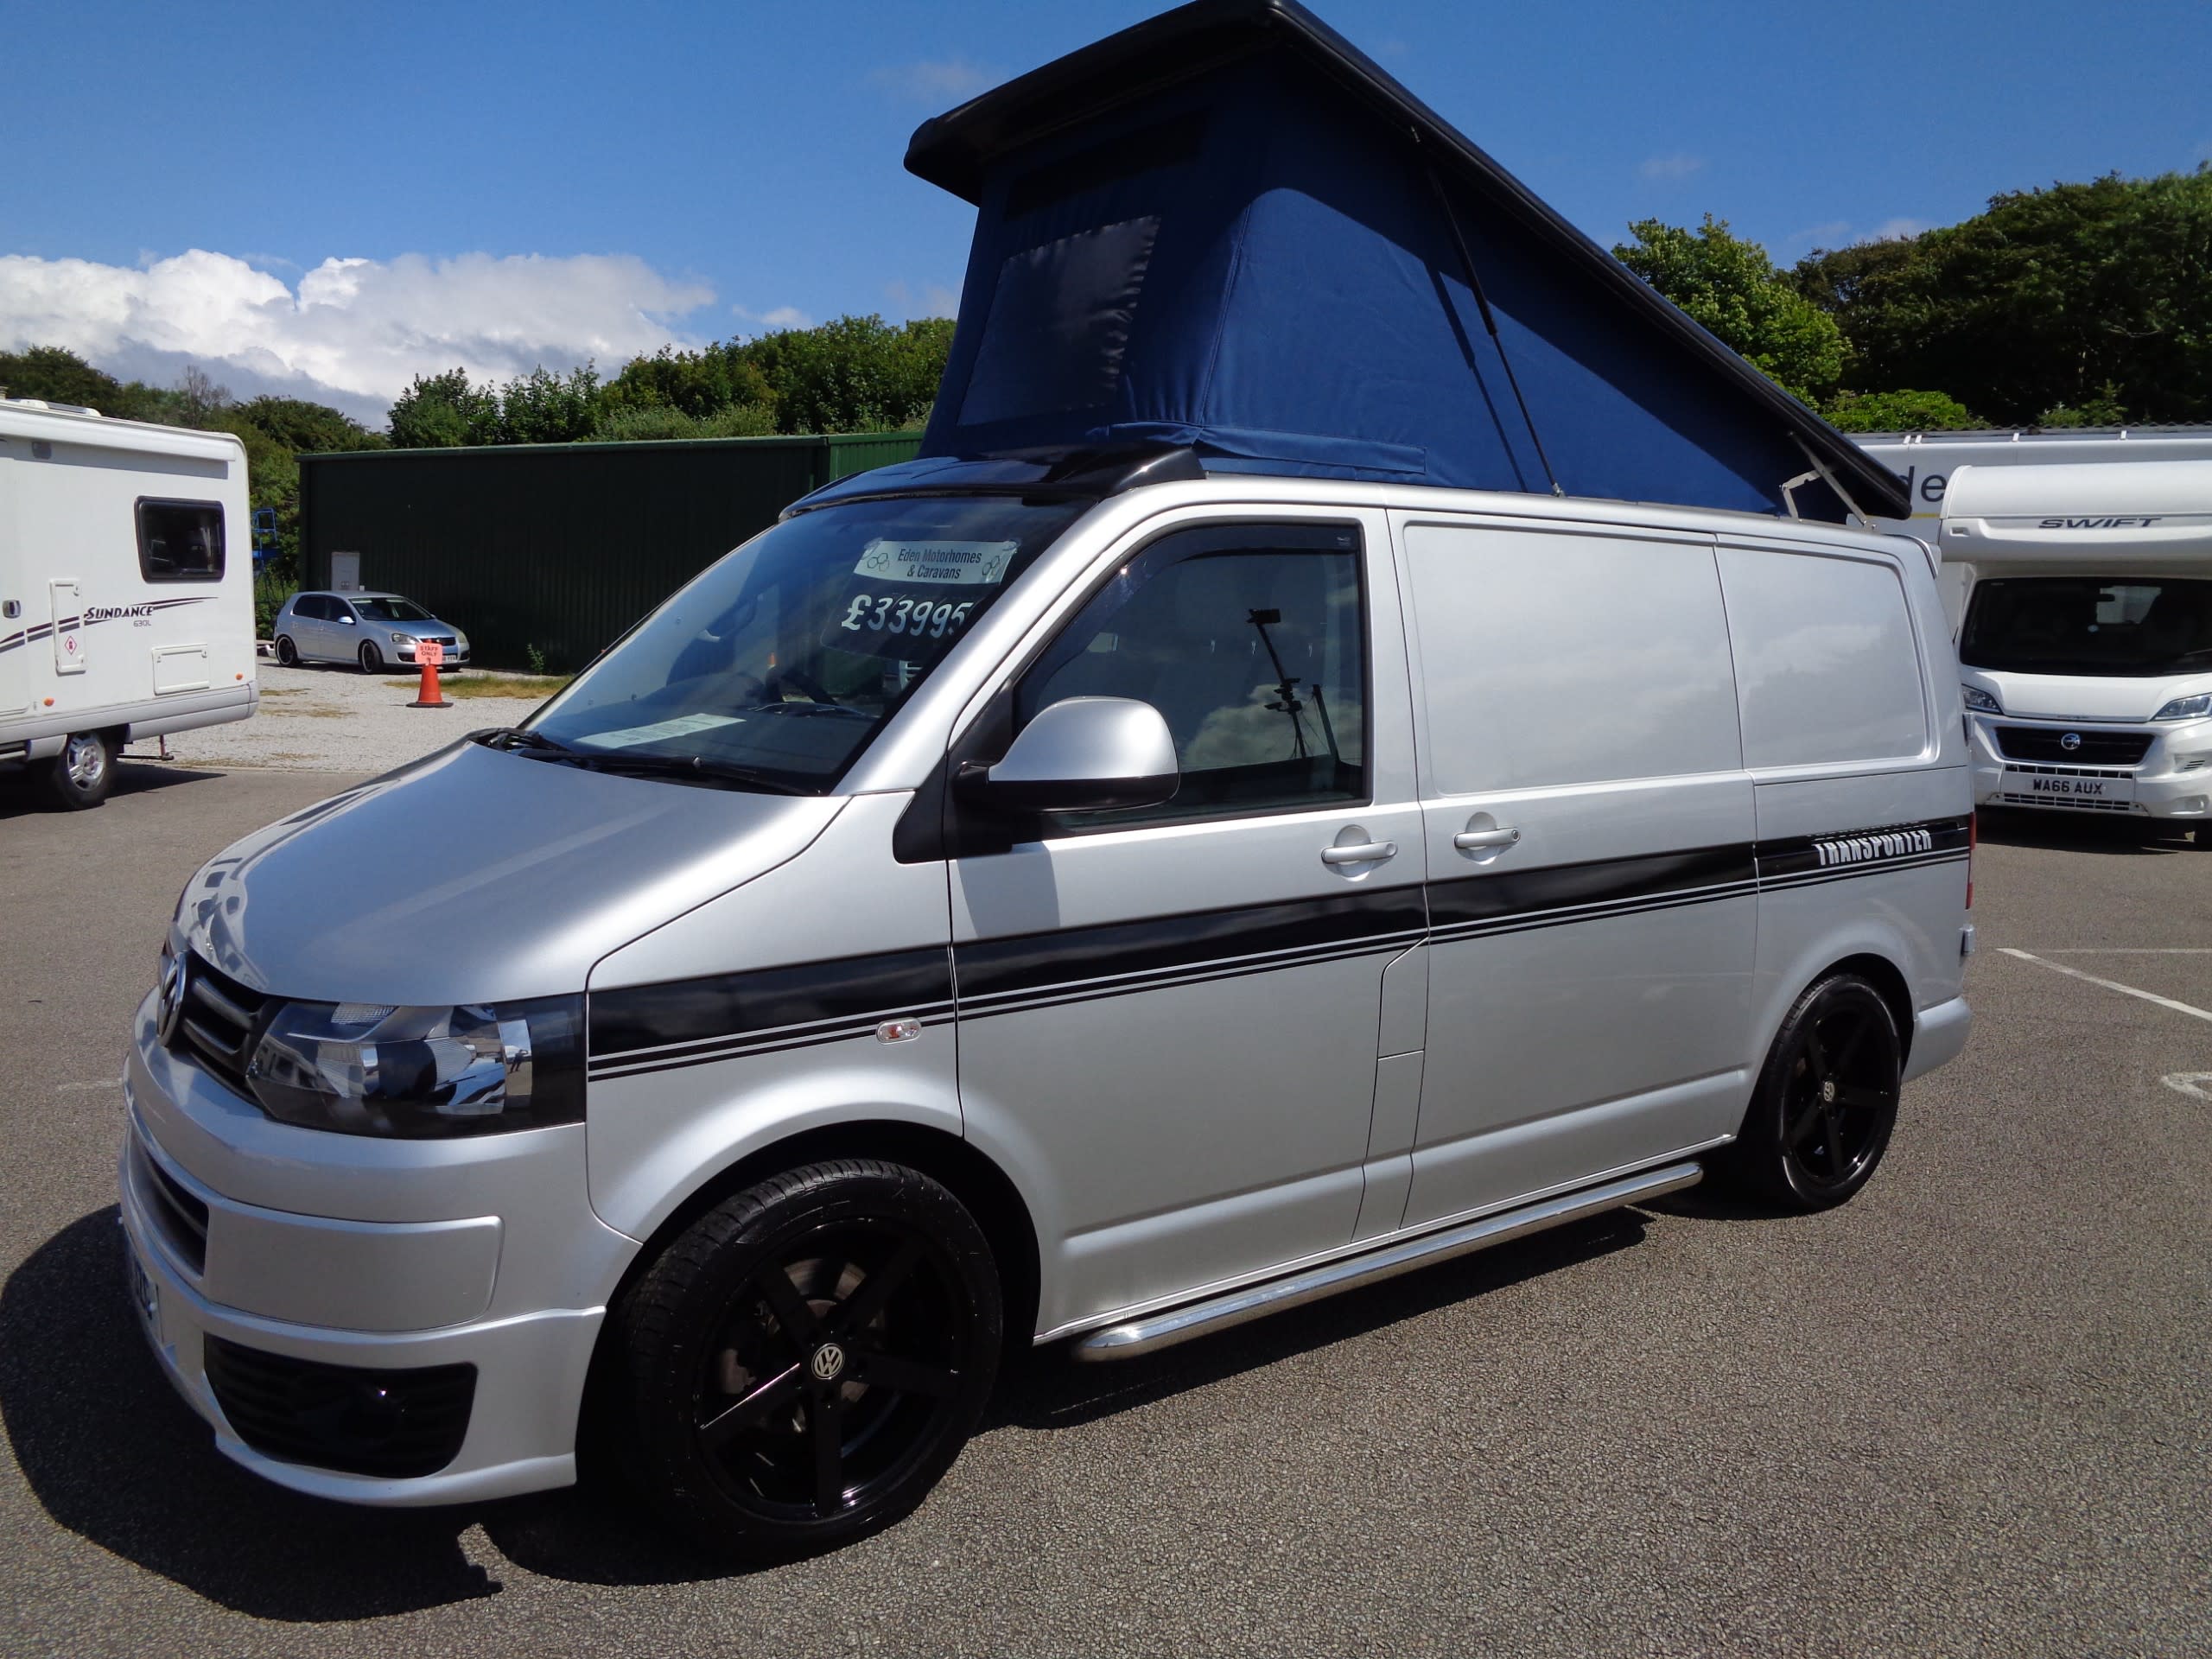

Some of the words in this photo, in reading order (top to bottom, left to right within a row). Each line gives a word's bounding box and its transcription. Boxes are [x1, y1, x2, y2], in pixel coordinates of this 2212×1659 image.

[2038, 518, 2162, 529] SWIFT
[898, 548, 920, 563] Eden
[922, 549, 982, 564] Motorhomes
[906, 565, 915, 577] &
[917, 564, 962, 580] Caravans
[86, 607, 154, 620] SUNDANCE
[842, 594, 974, 639] £33995
[2033, 779, 2070, 793] WA66
[2075, 781, 2103, 795] AUX
[1814, 829, 1932, 866] TRANSPORTER
